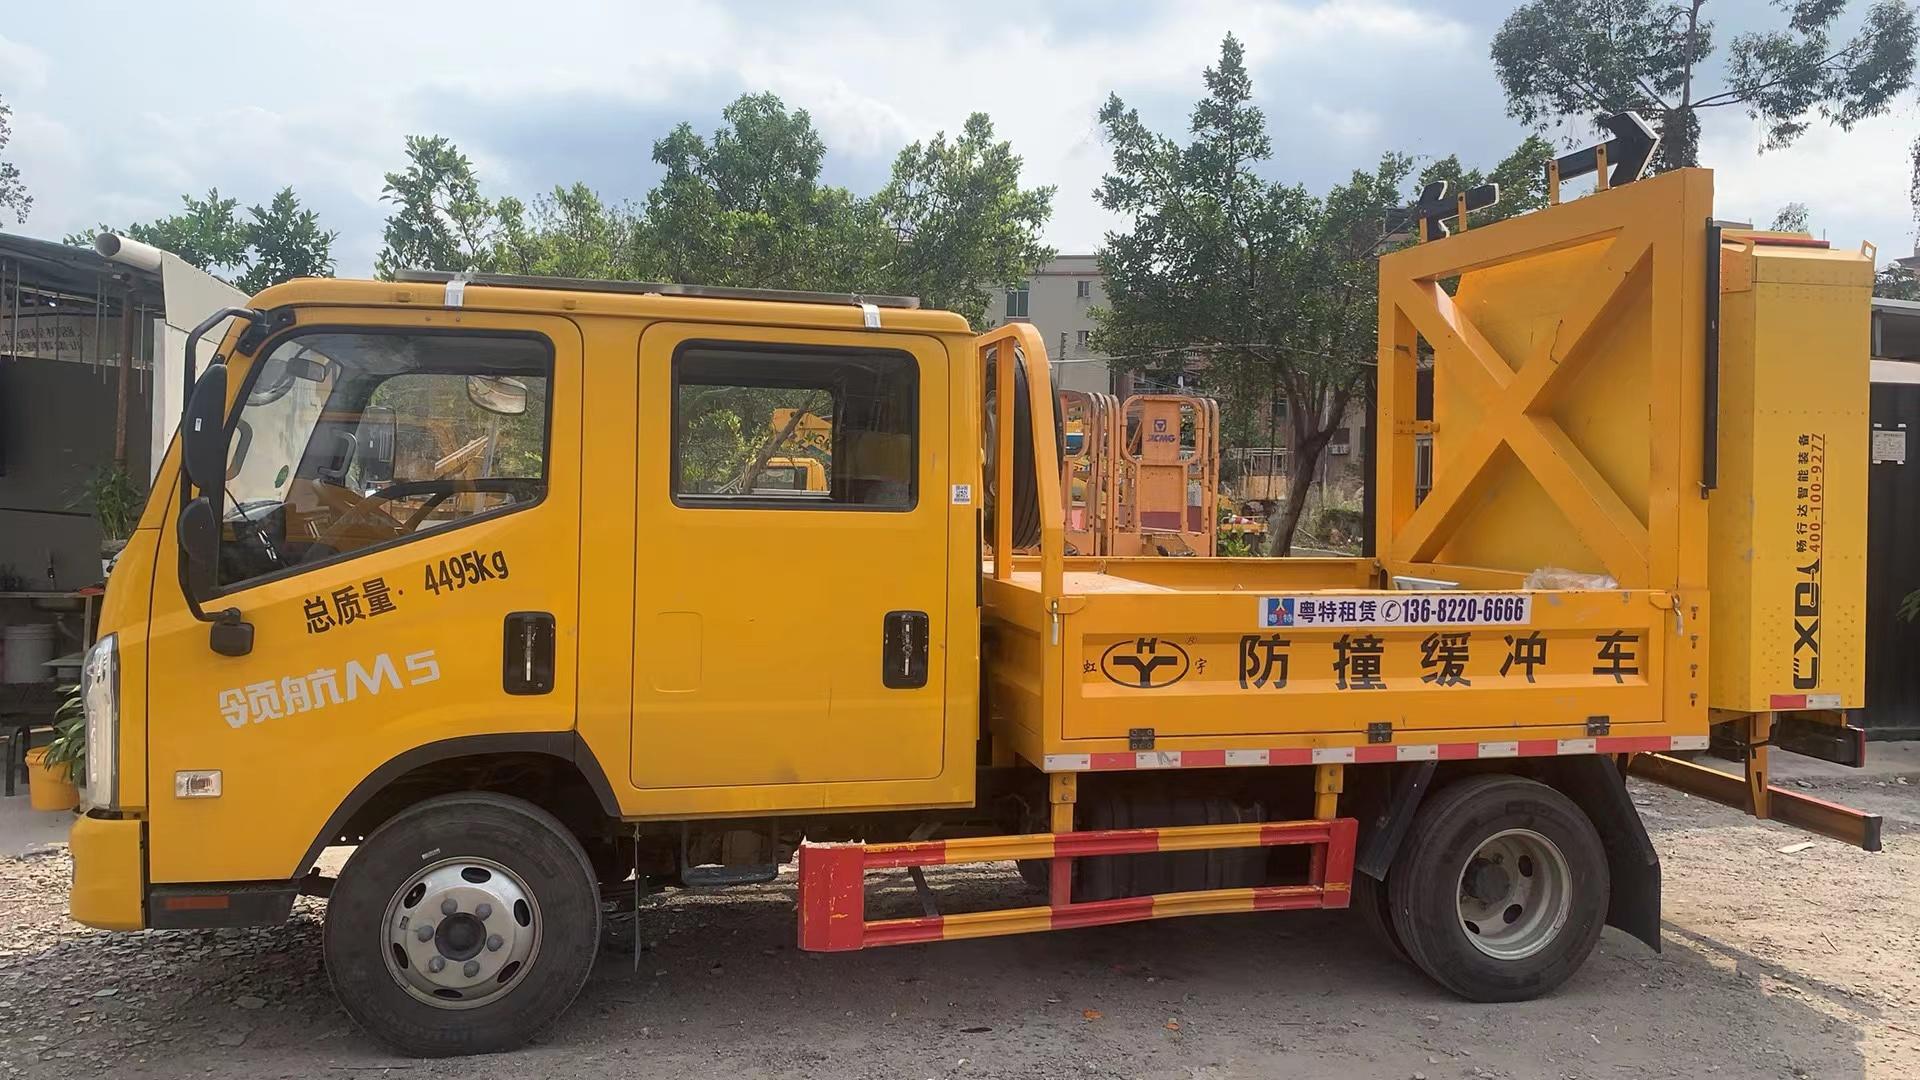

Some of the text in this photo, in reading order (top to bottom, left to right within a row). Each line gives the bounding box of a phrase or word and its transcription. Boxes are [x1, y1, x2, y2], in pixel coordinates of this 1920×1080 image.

[1809, 433, 1822, 552] 400-100-9277
[424, 550, 509, 595] 4495kg
[1298, 598, 1524, 623] 粤特租赁 136-8220-6666
[1239, 630, 1639, 690] 防撞缓冲车
